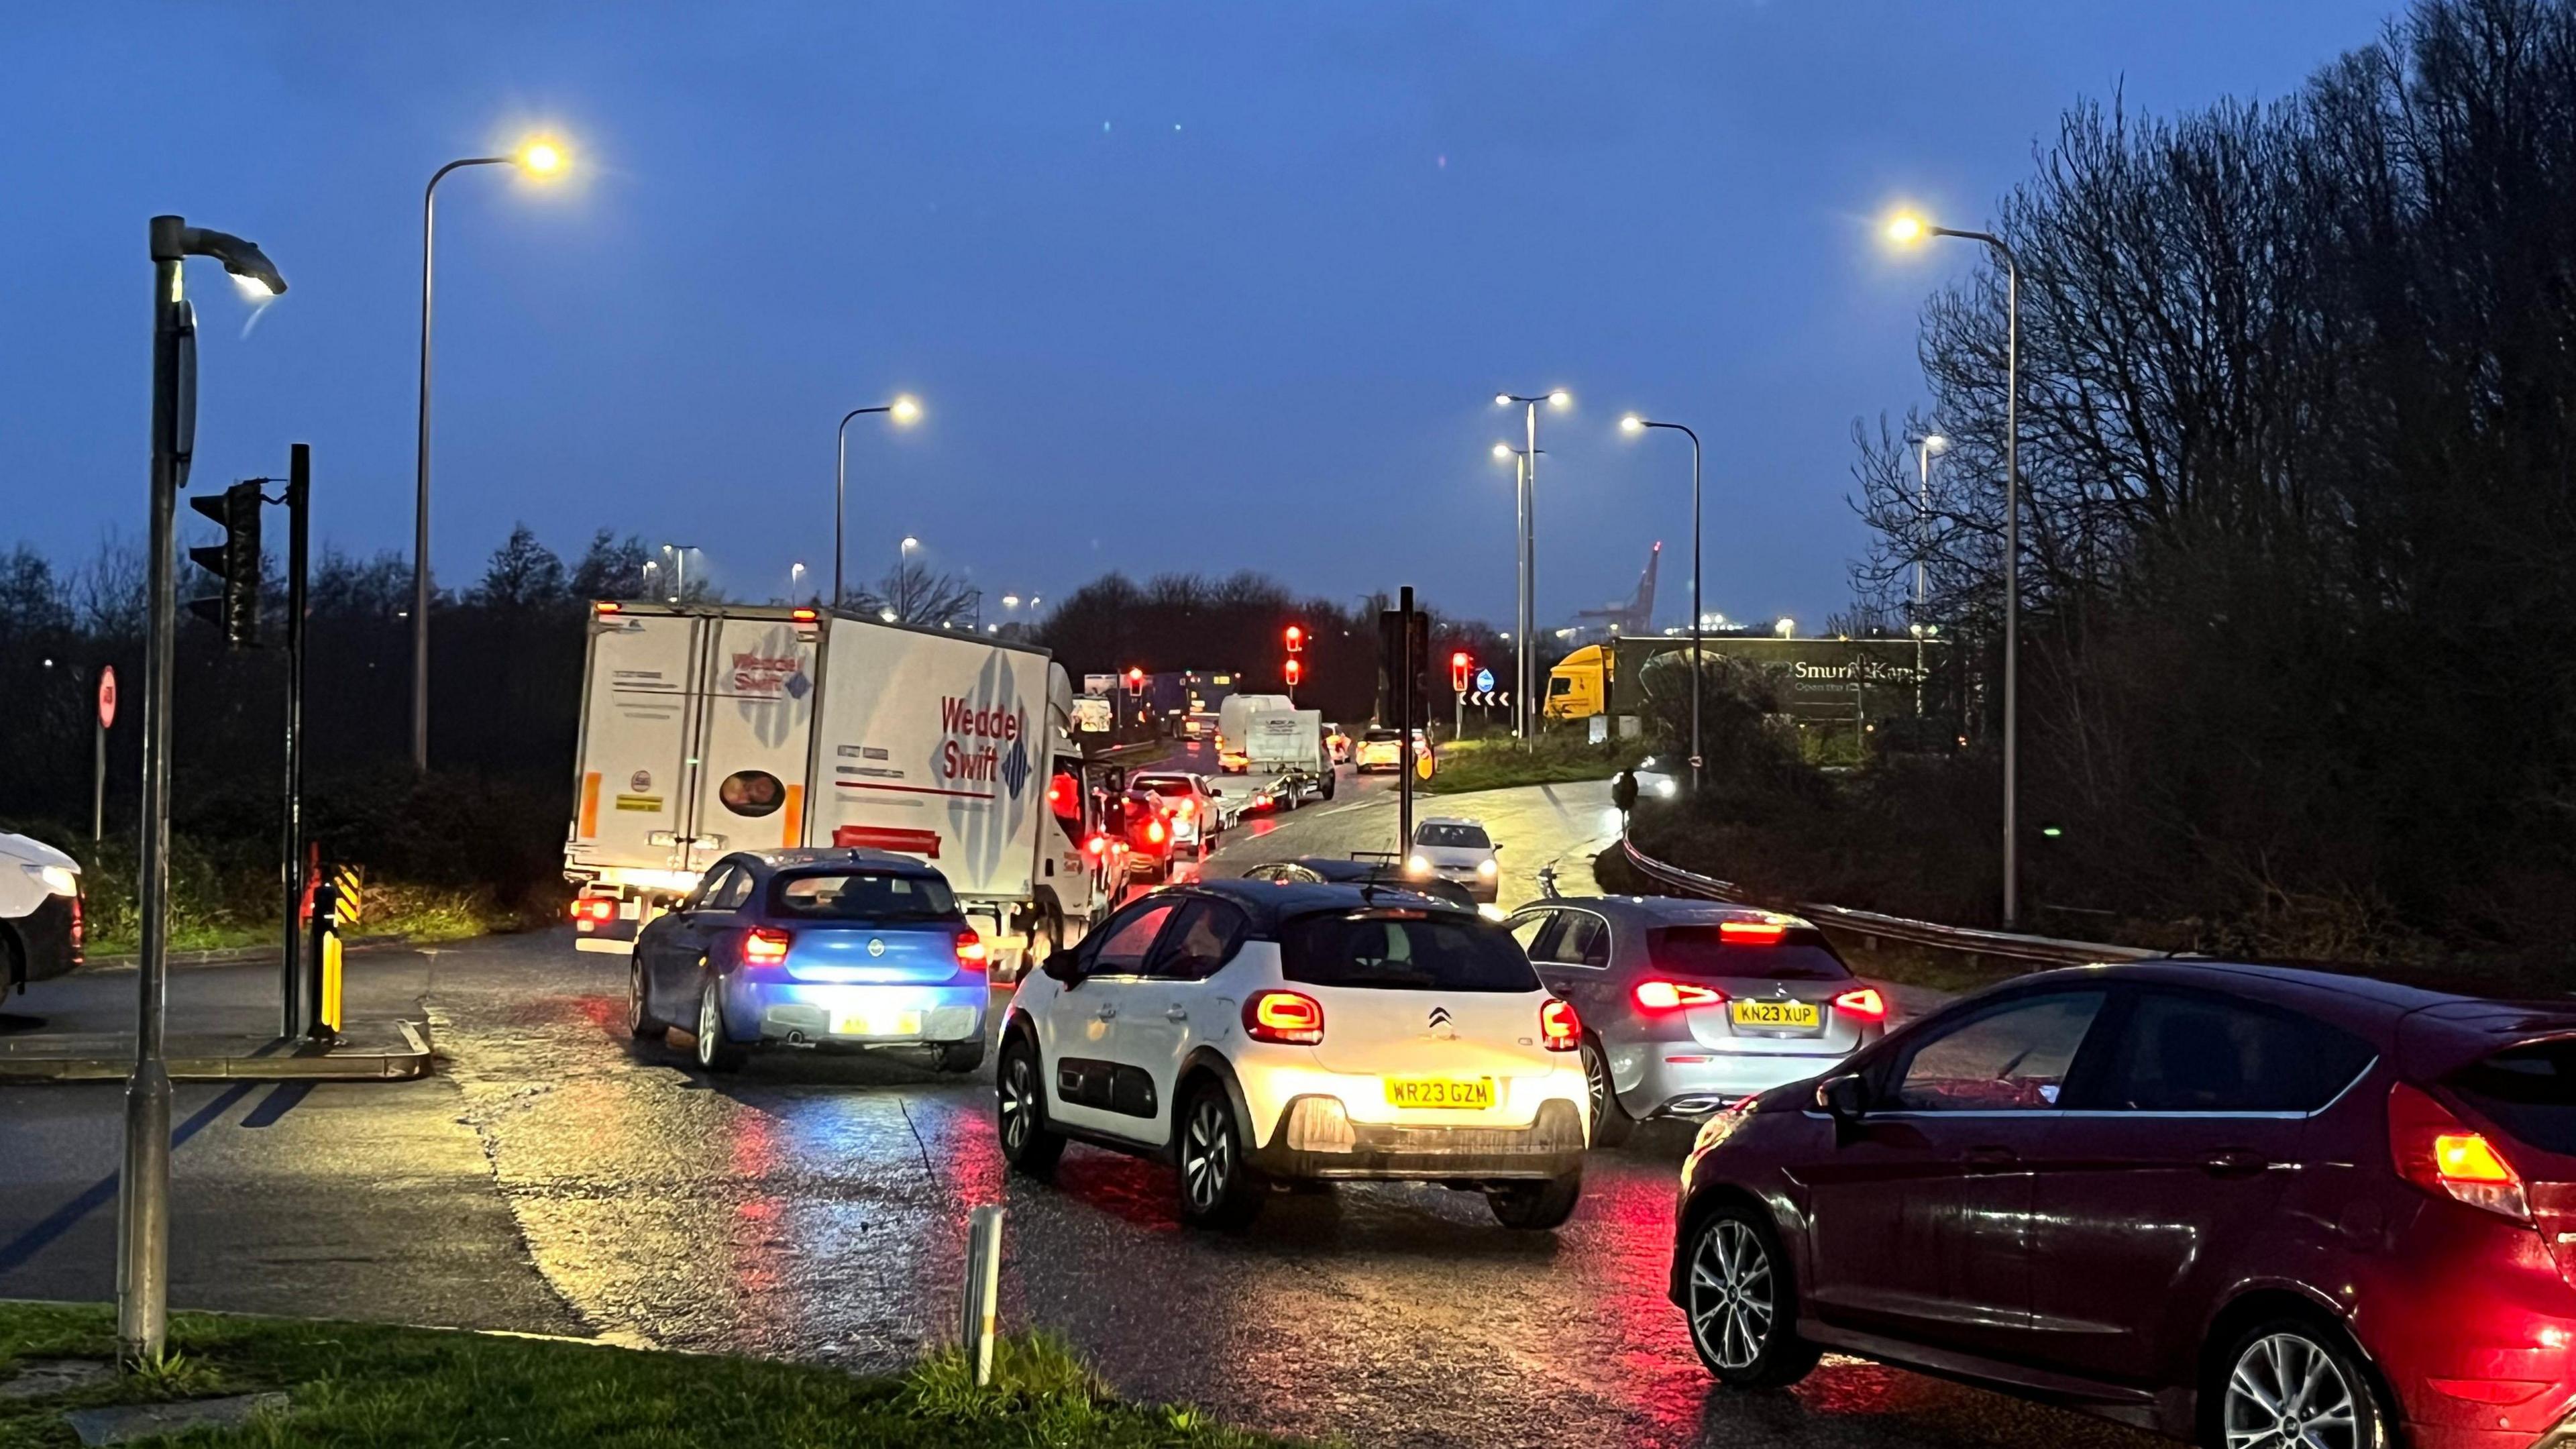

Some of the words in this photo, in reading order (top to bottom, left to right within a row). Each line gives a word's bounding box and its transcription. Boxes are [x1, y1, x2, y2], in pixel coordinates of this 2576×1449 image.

[942, 696, 1024, 741] Weddel
[943, 740, 998, 782] Swift
[1741, 1006, 1779, 1021] KN23
[1784, 1008, 1811, 1022] XUP
[1394, 1083, 1444, 1102] WR23
[1451, 1083, 1487, 1102] GZM
